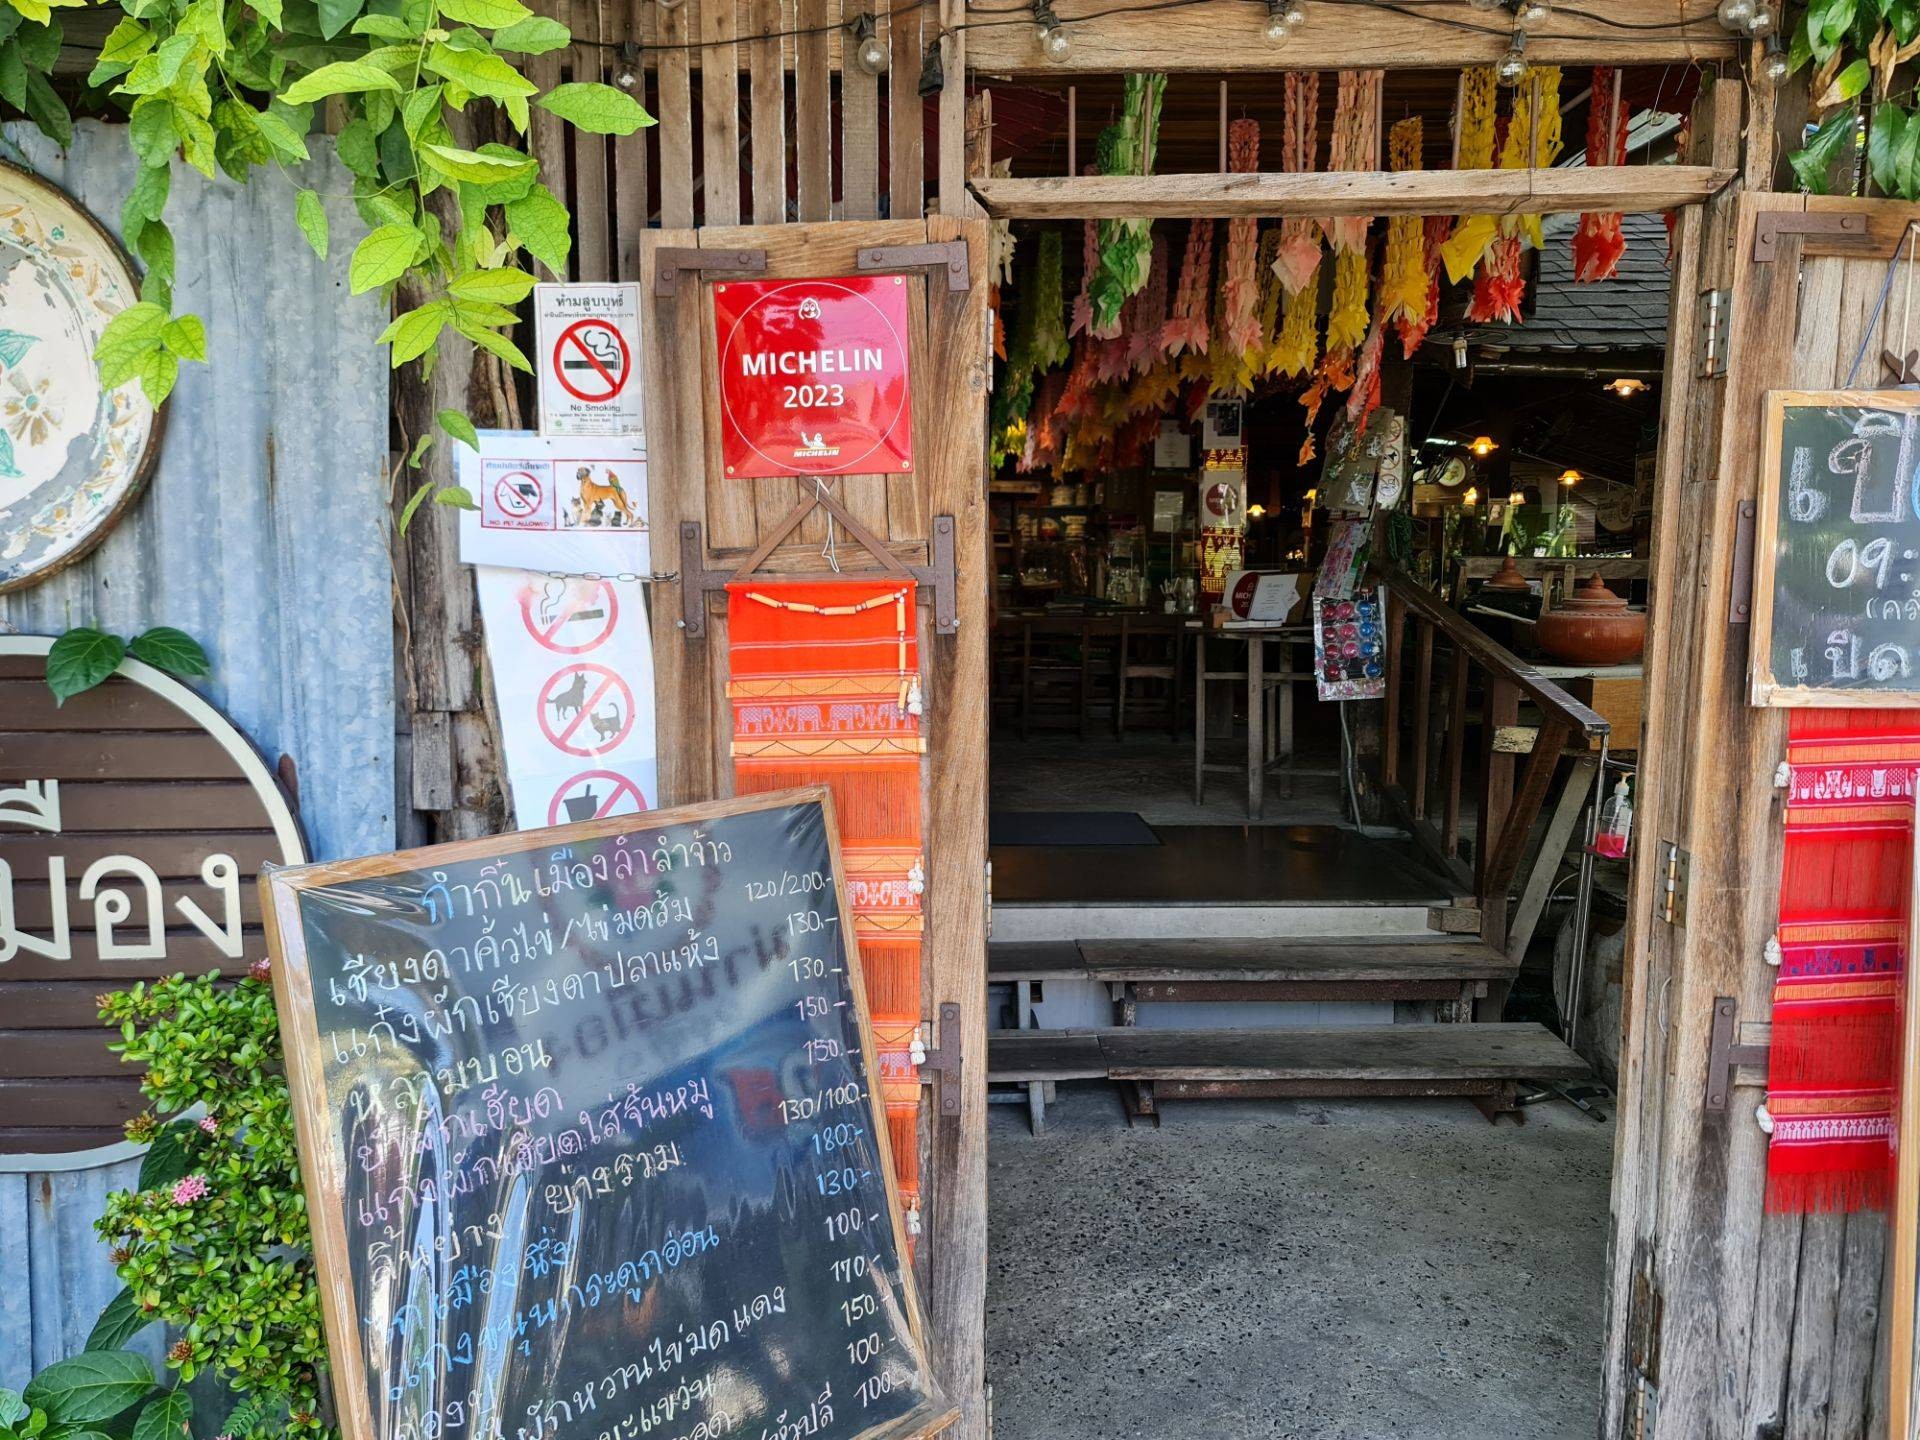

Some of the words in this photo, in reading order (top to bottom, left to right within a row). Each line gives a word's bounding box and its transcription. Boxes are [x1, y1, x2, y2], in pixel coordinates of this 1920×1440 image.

[556, 290, 624, 312] ห้ามสูบบุหรี่
[742, 348, 883, 376] MICHELIN
[570, 404, 582, 412] No
[585, 403, 621, 413] Smoking
[784, 384, 845, 408] 2023
[793, 448, 840, 458] MICHELIN
[1789, 412, 1920, 523] เปิ
[545, 1141, 680, 1214] ย่างรวม
